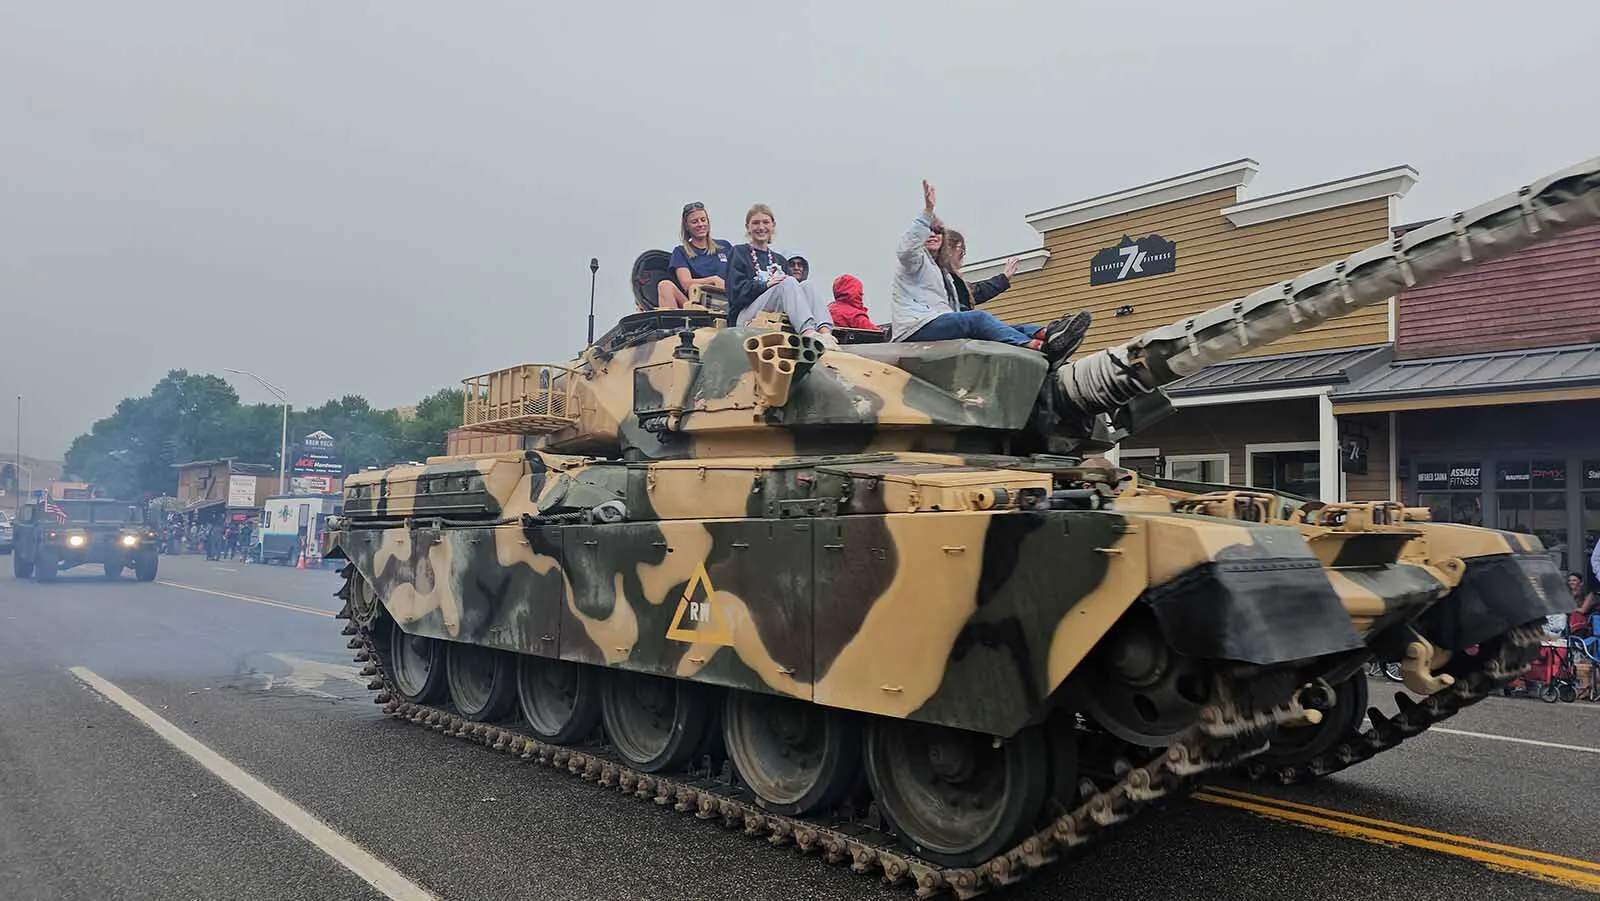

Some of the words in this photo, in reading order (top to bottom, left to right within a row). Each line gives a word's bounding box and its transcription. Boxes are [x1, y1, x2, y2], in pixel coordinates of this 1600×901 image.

[1094, 261, 1124, 273] ELEVATED
[1143, 252, 1171, 263] FITNESS
[294, 457, 315, 468] ACE
[1450, 468, 1480, 477] ASSAULT
[1450, 477, 1479, 486] FITNESS
